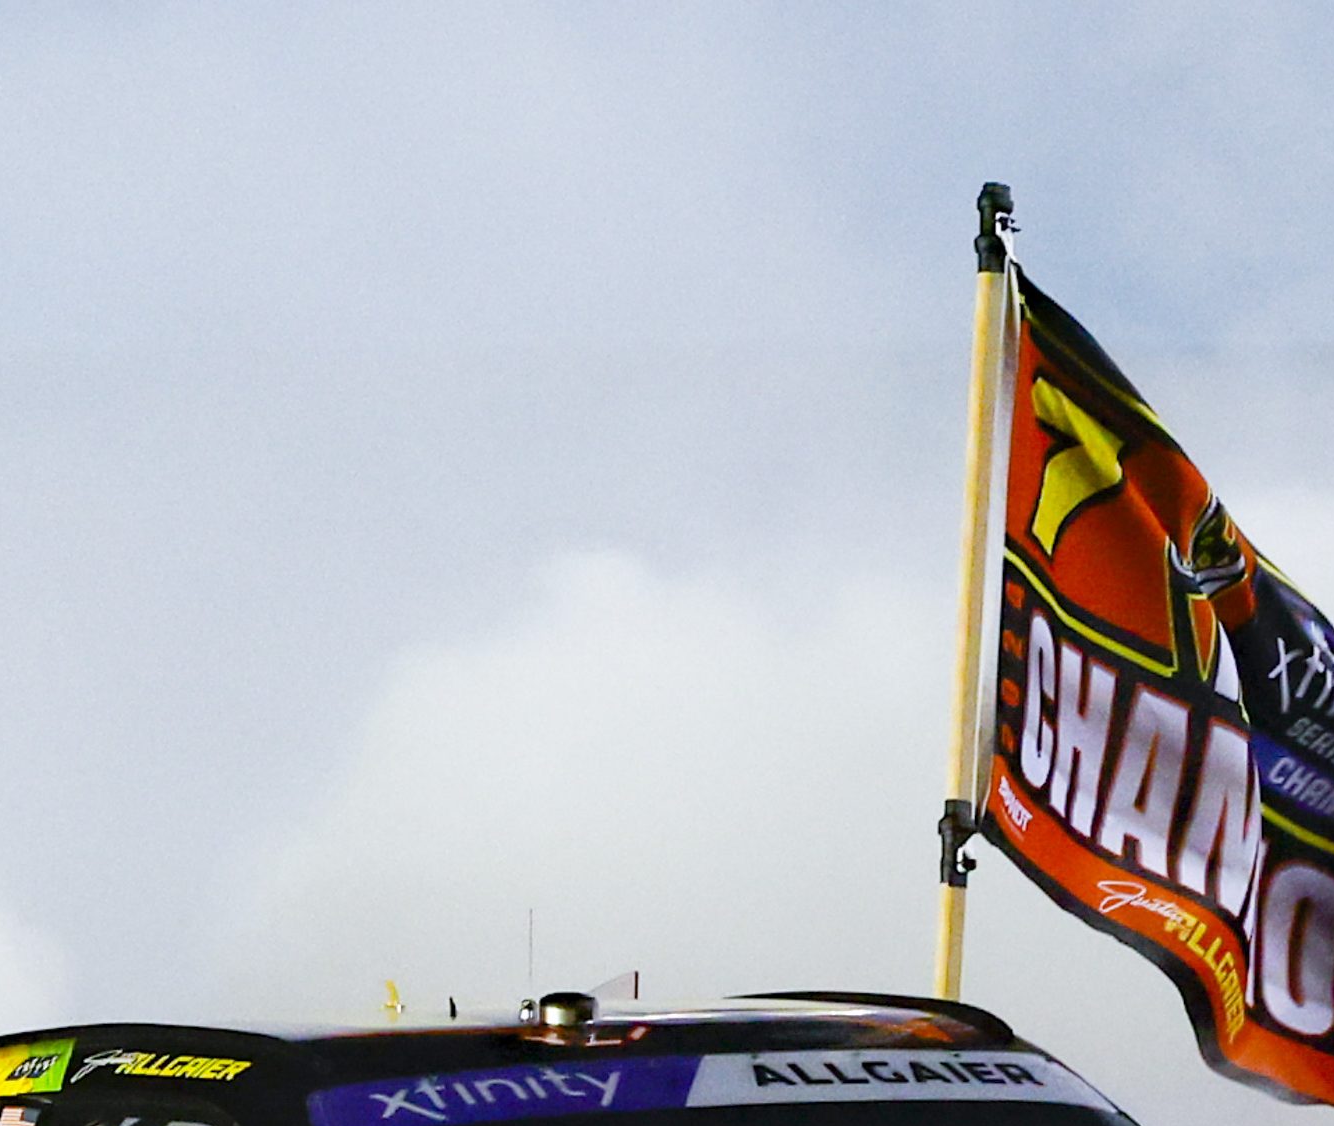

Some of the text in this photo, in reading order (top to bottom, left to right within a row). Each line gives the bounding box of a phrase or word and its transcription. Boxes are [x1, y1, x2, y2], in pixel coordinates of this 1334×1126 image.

[114, 1051, 252, 1082] ALLGAIER
[752, 1061, 1045, 1088] ALLGAIER
[368, 1067, 622, 1121] xfinity
